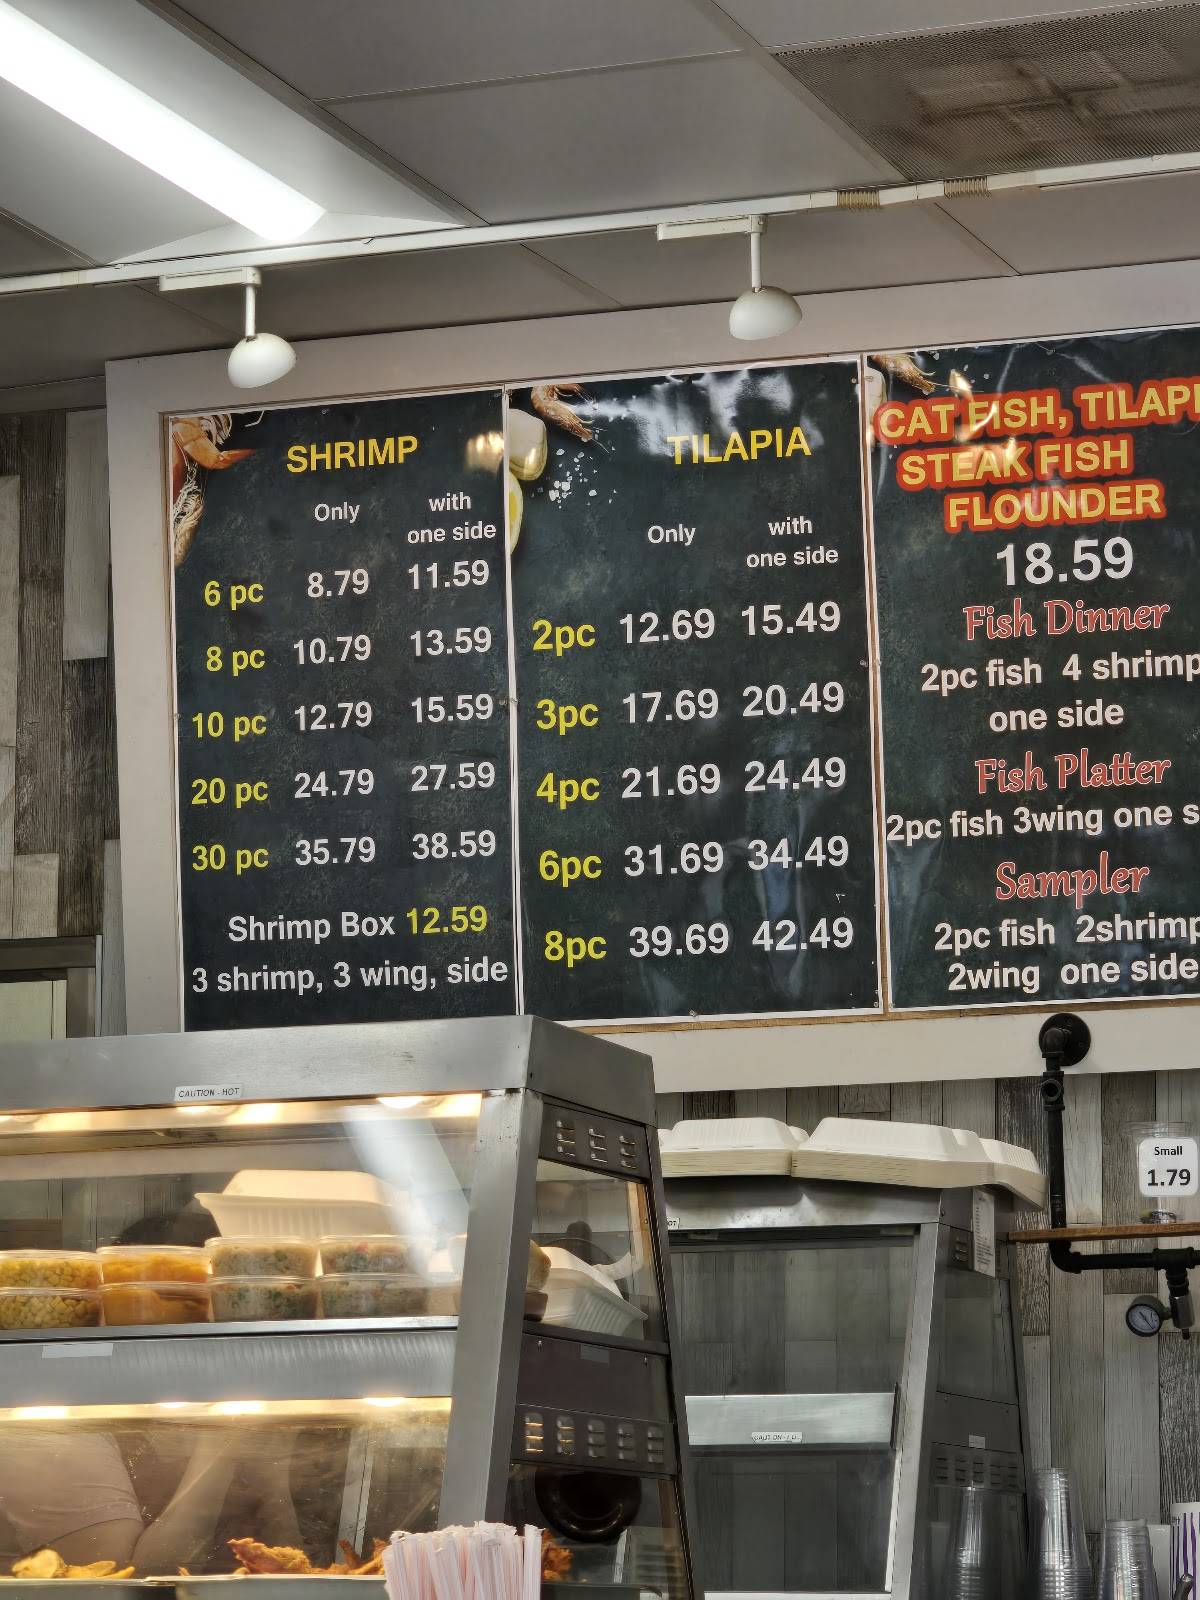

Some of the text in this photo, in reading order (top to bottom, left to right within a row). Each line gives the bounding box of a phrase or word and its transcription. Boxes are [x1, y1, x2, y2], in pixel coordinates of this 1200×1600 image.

[878, 404, 955, 439] CAT
[968, 395, 1067, 432] FISH,
[286, 435, 419, 473] SHRIMP
[667, 426, 812, 465] TILAPIA
[902, 439, 1129, 485] STEAK FISH
[314, 501, 360, 524] Only
[428, 491, 471, 512] with
[948, 484, 1162, 528] FLOUNDER
[407, 521, 497, 544] one side
[647, 523, 696, 546] Only
[768, 516, 813, 536] with
[746, 546, 839, 568] one side
[996, 536, 1133, 586] 18.59
[204, 559, 490, 611] 6 pc 8.79 11.59
[532, 600, 841, 657] 2pc 12.69 15.49
[962, 597, 1170, 641] Fish Dinner
[206, 626, 492, 677] 8 pc 10.79 13.59
[921, 649, 1200, 696] 2pc fish 4 shrimp
[192, 693, 494, 742] 10 pc 12.79 15.59
[535, 681, 845, 736] 3pc 17.69 20.49
[989, 698, 1124, 733] one side
[191, 761, 496, 809] 20 pc 24.79 27.59
[535, 756, 847, 810] 4pc 21.69 24.49
[974, 748, 1172, 795] Fish Platter
[886, 814, 942, 847] 2pc
[949, 810, 1003, 838] fish
[1013, 805, 1103, 836] 3wing
[1113, 805, 1173, 828] one
[192, 829, 496, 876] 30 pc 35.79 38.59
[539, 835, 849, 888] 6pc 31.69 34.49
[995, 850, 1150, 910] Sampler
[228, 905, 488, 945] Shrimp Box 12.59
[544, 916, 854, 968] 8pc 39.69 42.49
[934, 922, 991, 956] 2pc
[999, 917, 1056, 947] fish
[192, 955, 508, 996] 3 shrimp, 3 wing, side
[947, 953, 1199, 994] 2wing one side
[178, 1089, 215, 1098] CAUTION
[222, 1087, 240, 1096] HOT
[1154, 1145, 1183, 1156] Small
[1147, 1168, 1191, 1187] 1.79
